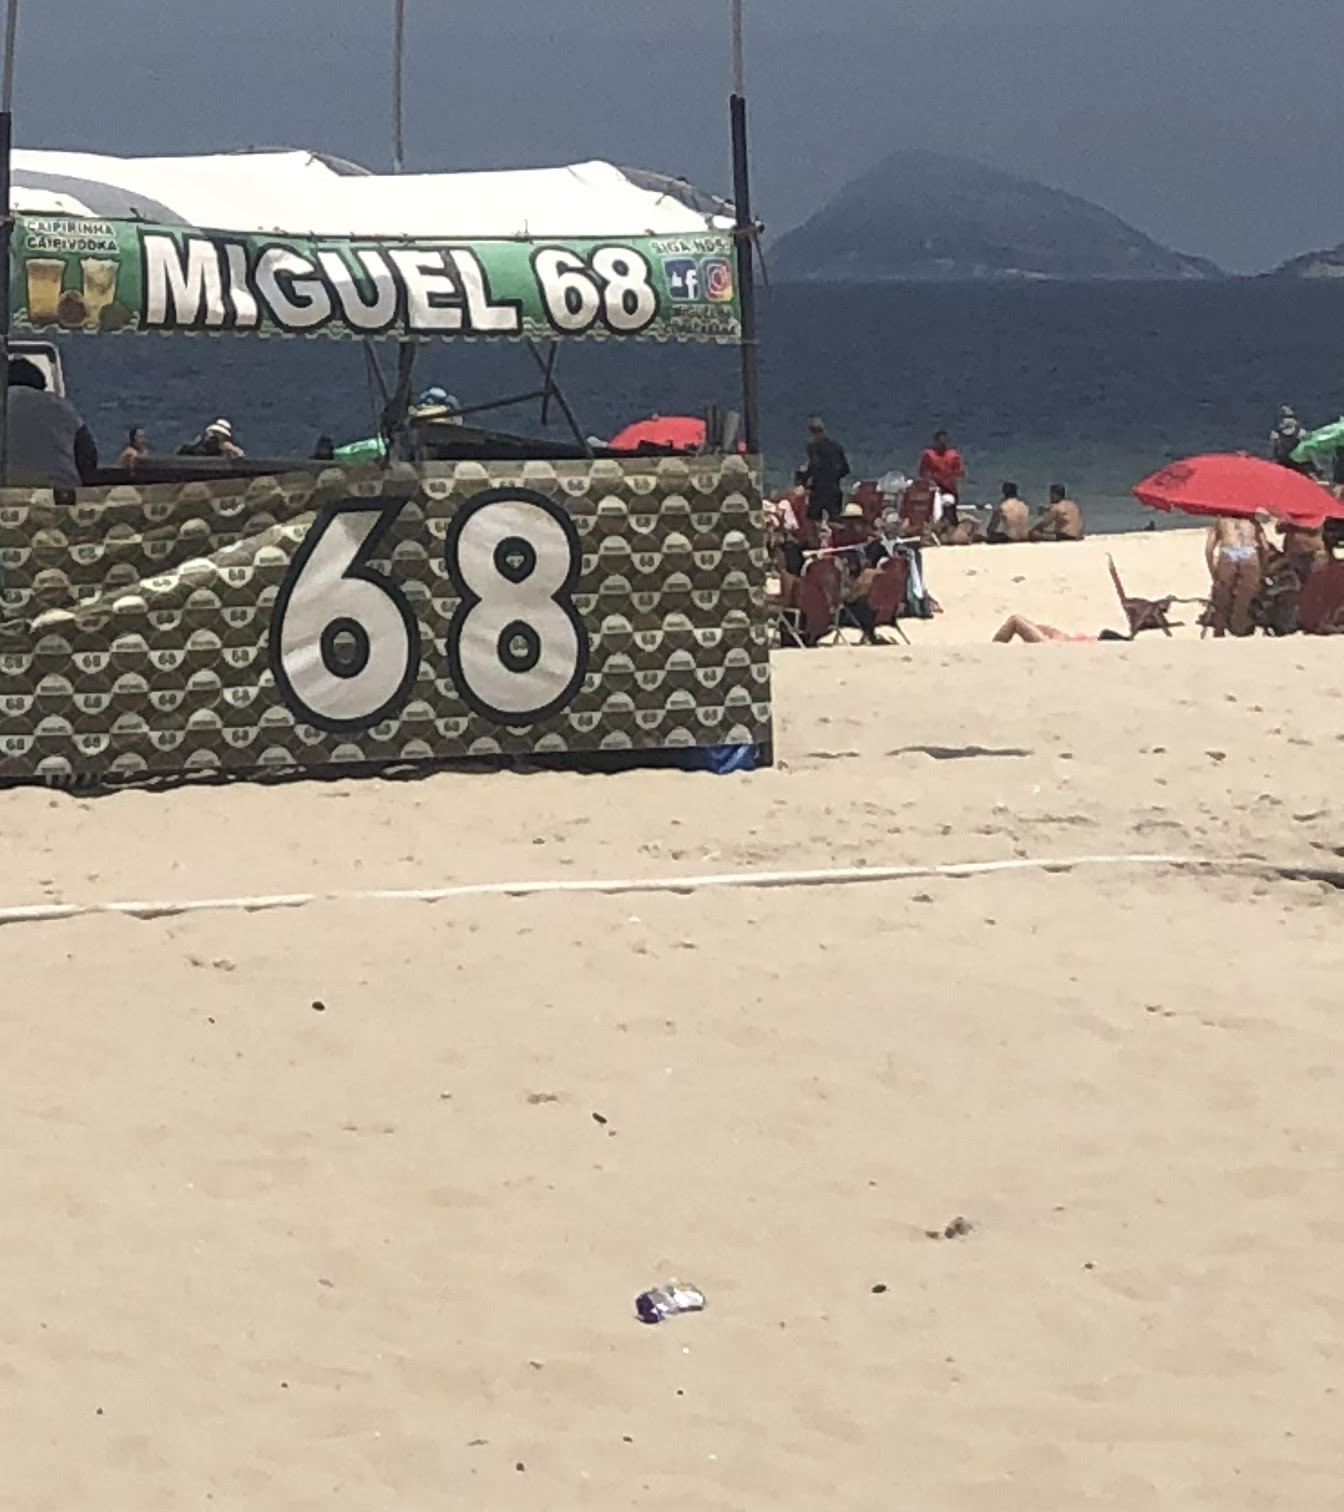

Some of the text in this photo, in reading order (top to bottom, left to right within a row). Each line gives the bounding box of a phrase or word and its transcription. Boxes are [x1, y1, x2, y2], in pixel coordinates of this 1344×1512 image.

[138, 228, 659, 336] MIGUEL 68
[271, 489, 588, 729] 68
